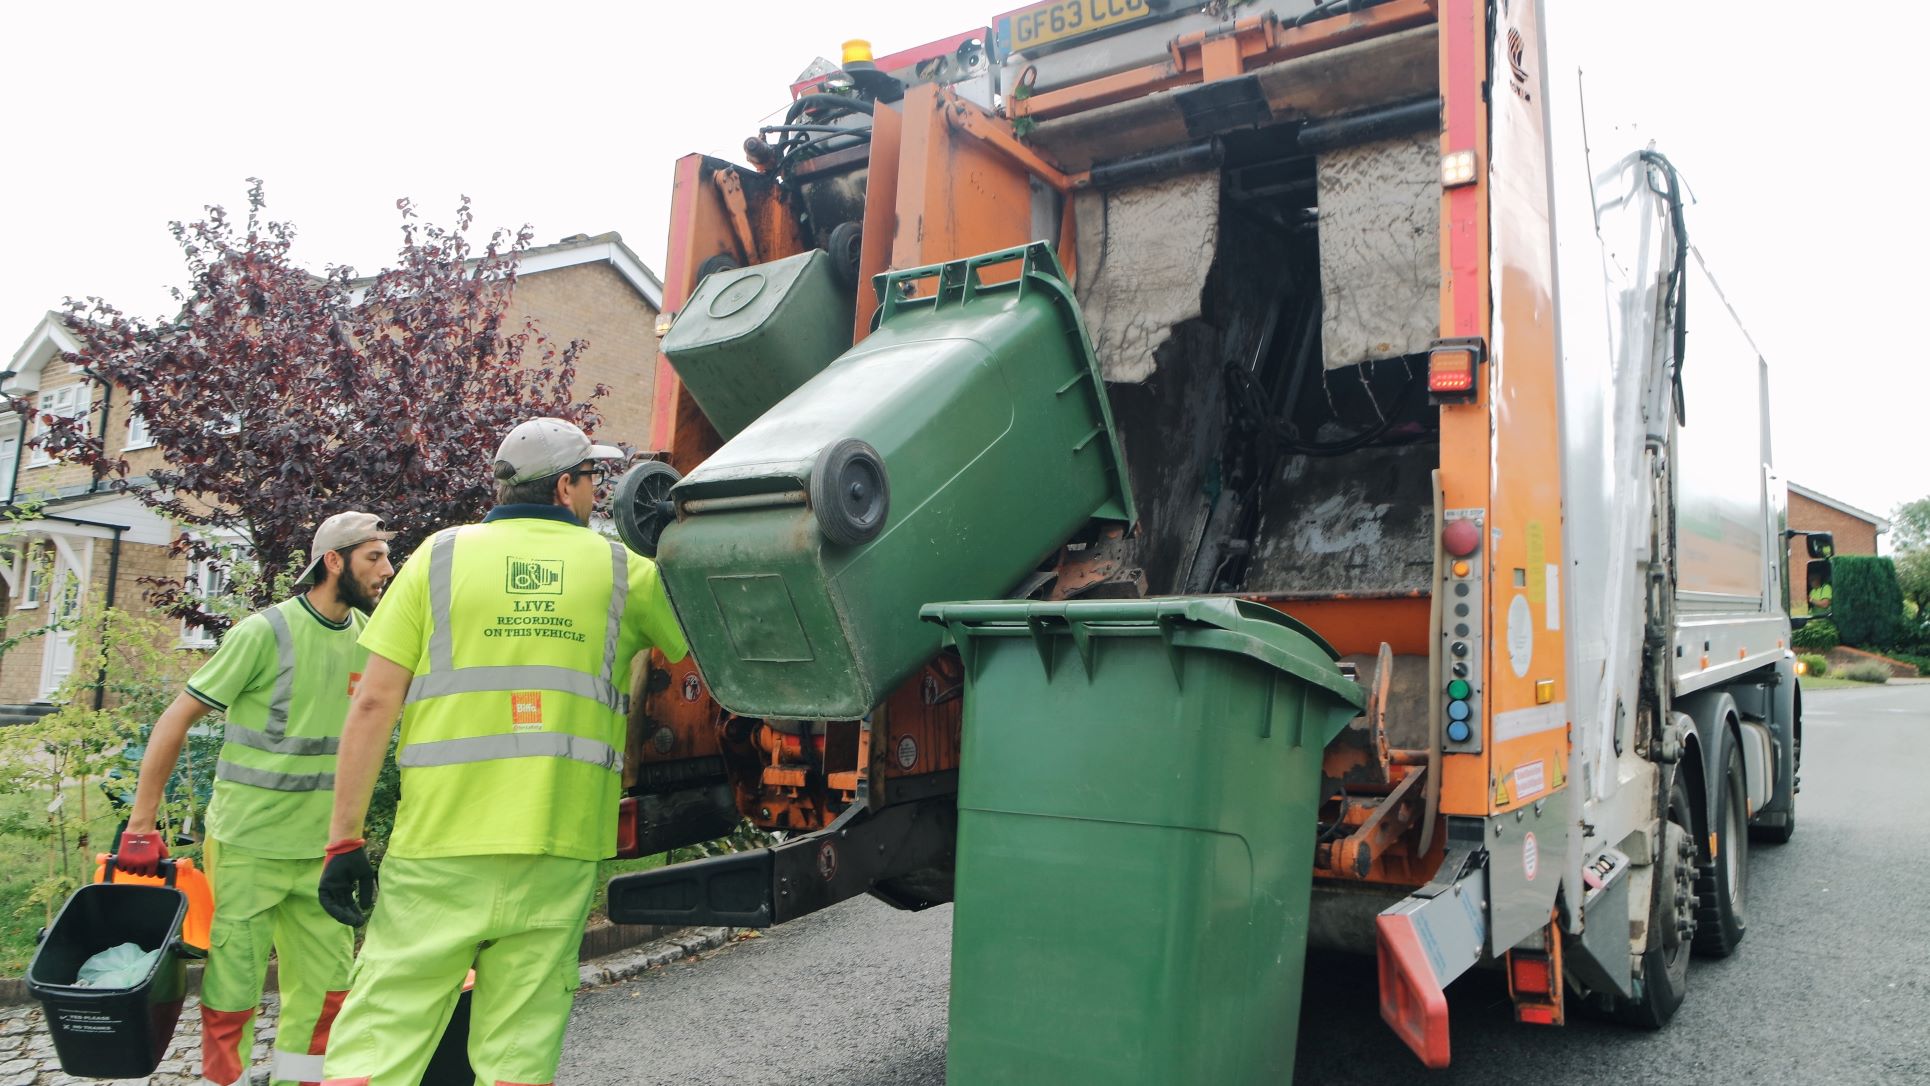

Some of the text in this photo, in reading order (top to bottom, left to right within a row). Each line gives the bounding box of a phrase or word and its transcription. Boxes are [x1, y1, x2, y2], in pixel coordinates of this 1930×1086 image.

[1016, 0, 1083, 42] GF63
[513, 600, 555, 612] LIVE
[497, 616, 573, 628] RECORDING
[484, 628, 586, 642] ON THIS VEHICLE
